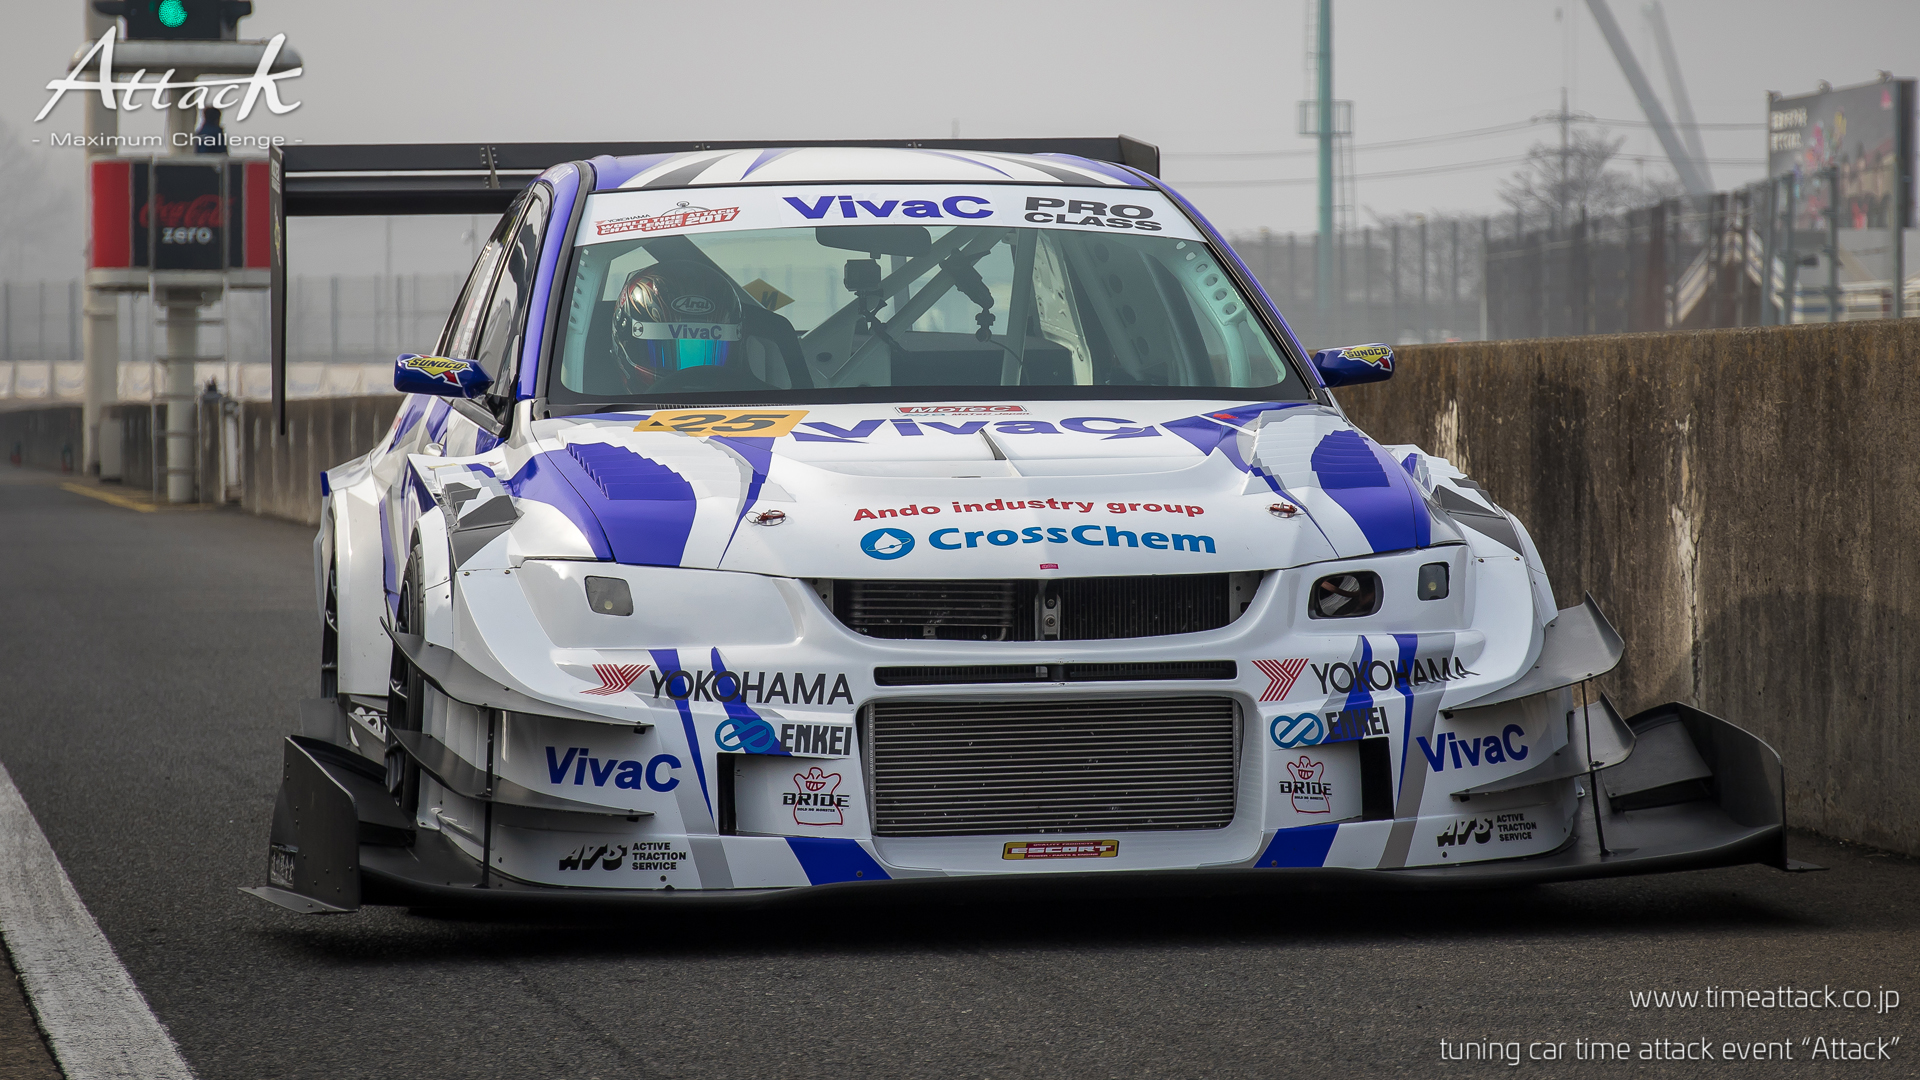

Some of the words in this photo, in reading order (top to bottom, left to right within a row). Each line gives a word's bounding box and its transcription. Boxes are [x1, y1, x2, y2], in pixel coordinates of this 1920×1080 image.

[782, 195, 994, 220] VivaC
[1024, 196, 1154, 220] PRO
[601, 219, 649, 230] WORLD
[688, 208, 735, 218] ATTACK
[685, 212, 735, 225] 2017
[1024, 212, 1162, 232] CLASS
[162, 226, 213, 245] zero
[668, 324, 722, 340] VivaC
[1347, 347, 1387, 357] SUNOCO
[409, 358, 465, 370] SUNOCO
[669, 414, 790, 432] 25
[800, 416, 1147, 439] VivaC
[853, 503, 941, 521] Ando
[951, 497, 1094, 513] industry
[1106, 501, 1205, 517] group
[928, 524, 1217, 554] CrossChem
[1310, 656, 1481, 694] YOKOHAMA
[650, 669, 854, 705] YOKOHAMA
[1325, 706, 1390, 741] ENKEI
[781, 723, 851, 756] ENKEI
[1415, 723, 1529, 773] VivaC
[545, 746, 682, 793] VivaC
[1279, 780, 1332, 796] BRIDE
[782, 792, 850, 808] BRIDE
[1496, 813, 1525, 823] ACTIVE
[1497, 822, 1537, 832] TRACTION
[1499, 831, 1533, 841] SERVICE
[632, 842, 671, 850] ACTIVE
[1011, 845, 1111, 854] ESCORT
[632, 852, 687, 861] TRACTION
[632, 862, 677, 870] SERVICE
